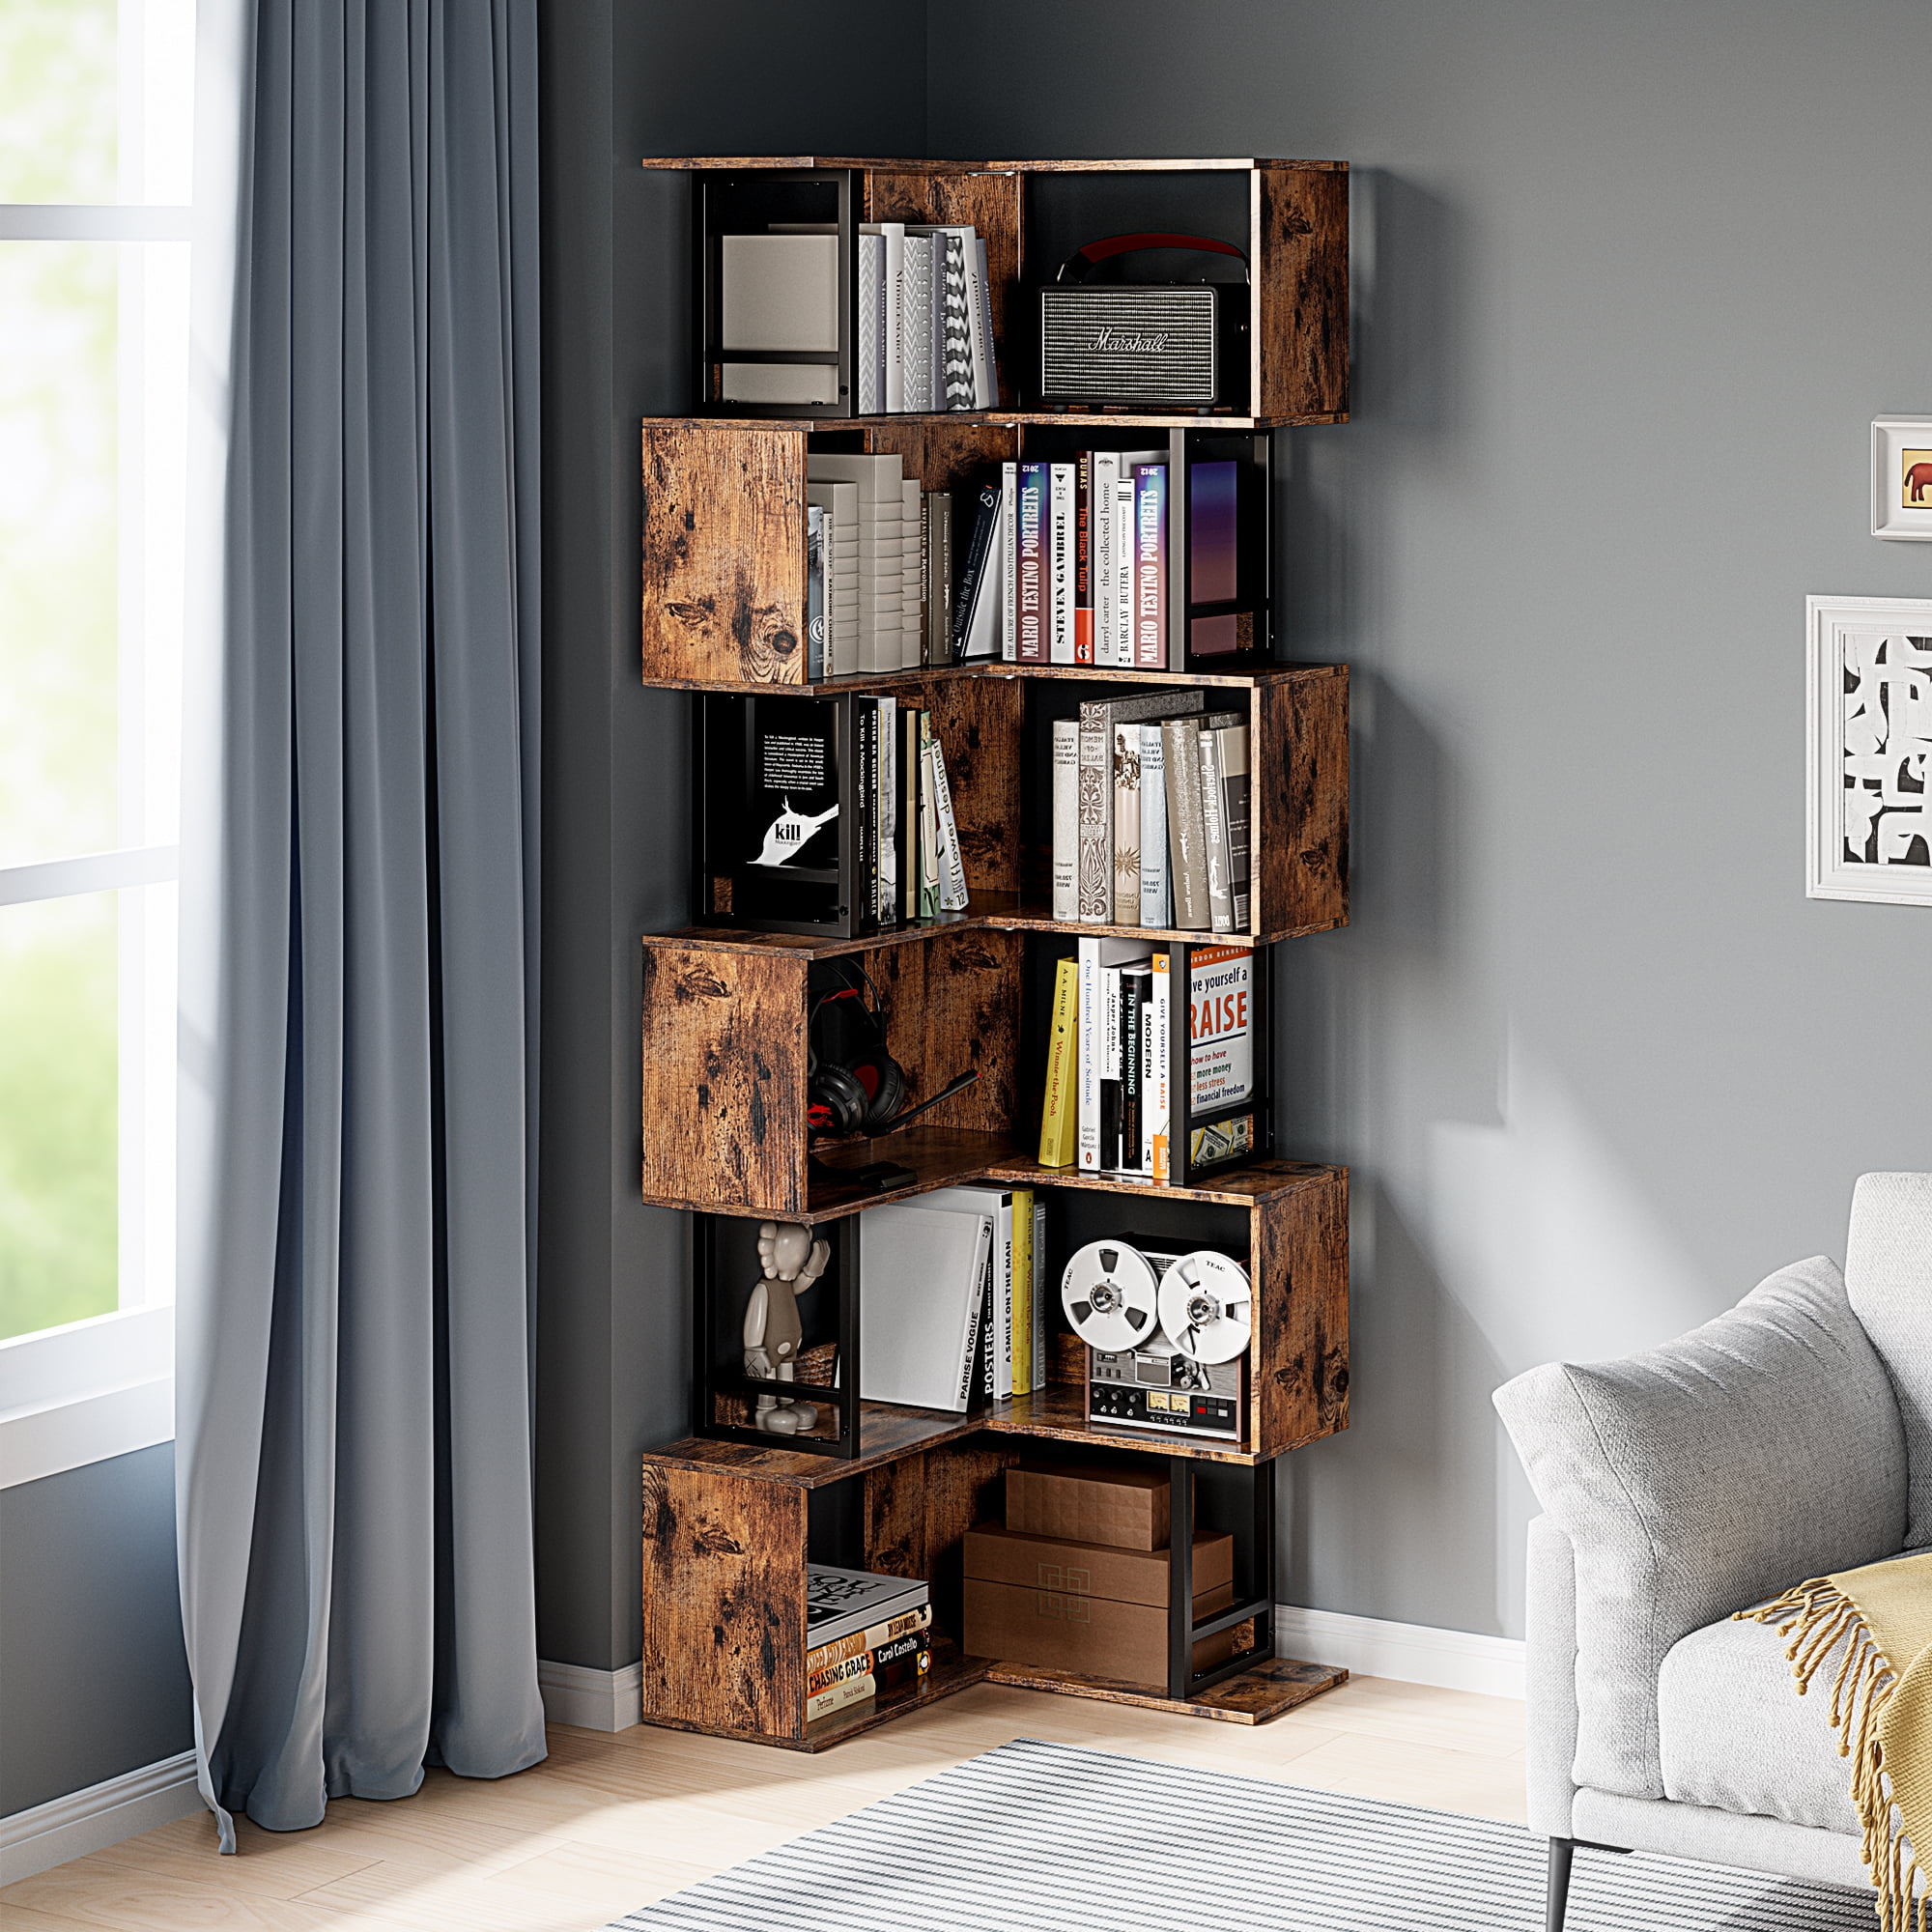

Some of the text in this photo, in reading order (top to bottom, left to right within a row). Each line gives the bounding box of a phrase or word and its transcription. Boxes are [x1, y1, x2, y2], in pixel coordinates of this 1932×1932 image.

[1088, 326, 1169, 353] Marshall
[1022, 465, 1039, 473] 2012
[1140, 468, 1158, 476] 2012
[1100, 482, 1110, 586] the collected home
[1079, 507, 1088, 592] The Black Tulip
[1021, 487, 1038, 658] MARIO TESTINO PORTREITS
[1056, 512, 1065, 644] STEVEN GAMBREL
[1120, 566, 1129, 605] BUTERA
[1140, 490, 1157, 663] MARIO TESTINO PORTREITS
[952, 568, 975, 633] Outside the Box
[1007, 607, 1014, 617] OF
[1101, 626, 1111, 654] darryl
[1120, 609, 1129, 652] BARCLAY
[860, 714, 865, 725] To
[933, 743, 951, 814] designer
[947, 821, 960, 876] flower
[1205, 966, 1240, 994] yourself
[1241, 969, 1247, 981] a
[1127, 1009, 1136, 1031] THE
[1191, 991, 1247, 1039] RAISE
[1085, 1054, 1093, 1065] of
[1127, 1033, 1136, 1095] BEGINNING
[1191, 1050, 1227, 1065] how to have
[1197, 1063, 1232, 1079] more money
[1196, 1077, 1226, 1092] less stress
[1196, 1084, 1245, 1104] financial freedom
[1065, 1267, 1073, 1290] TEAC
[1206, 1261, 1226, 1272] TEAC
[1006, 1296, 1011, 1314] ON
[1037, 1321, 1045, 1337] ON
[960, 1311, 979, 1400] PARISE VOGUE
[983, 1321, 994, 1395] POSTERS
[1006, 1354, 1011, 1363] A
[878, 1637, 918, 1663] Carol Costello
[809, 1665, 844, 1692] CHASING
[844, 1654, 870, 1678] GRACE
